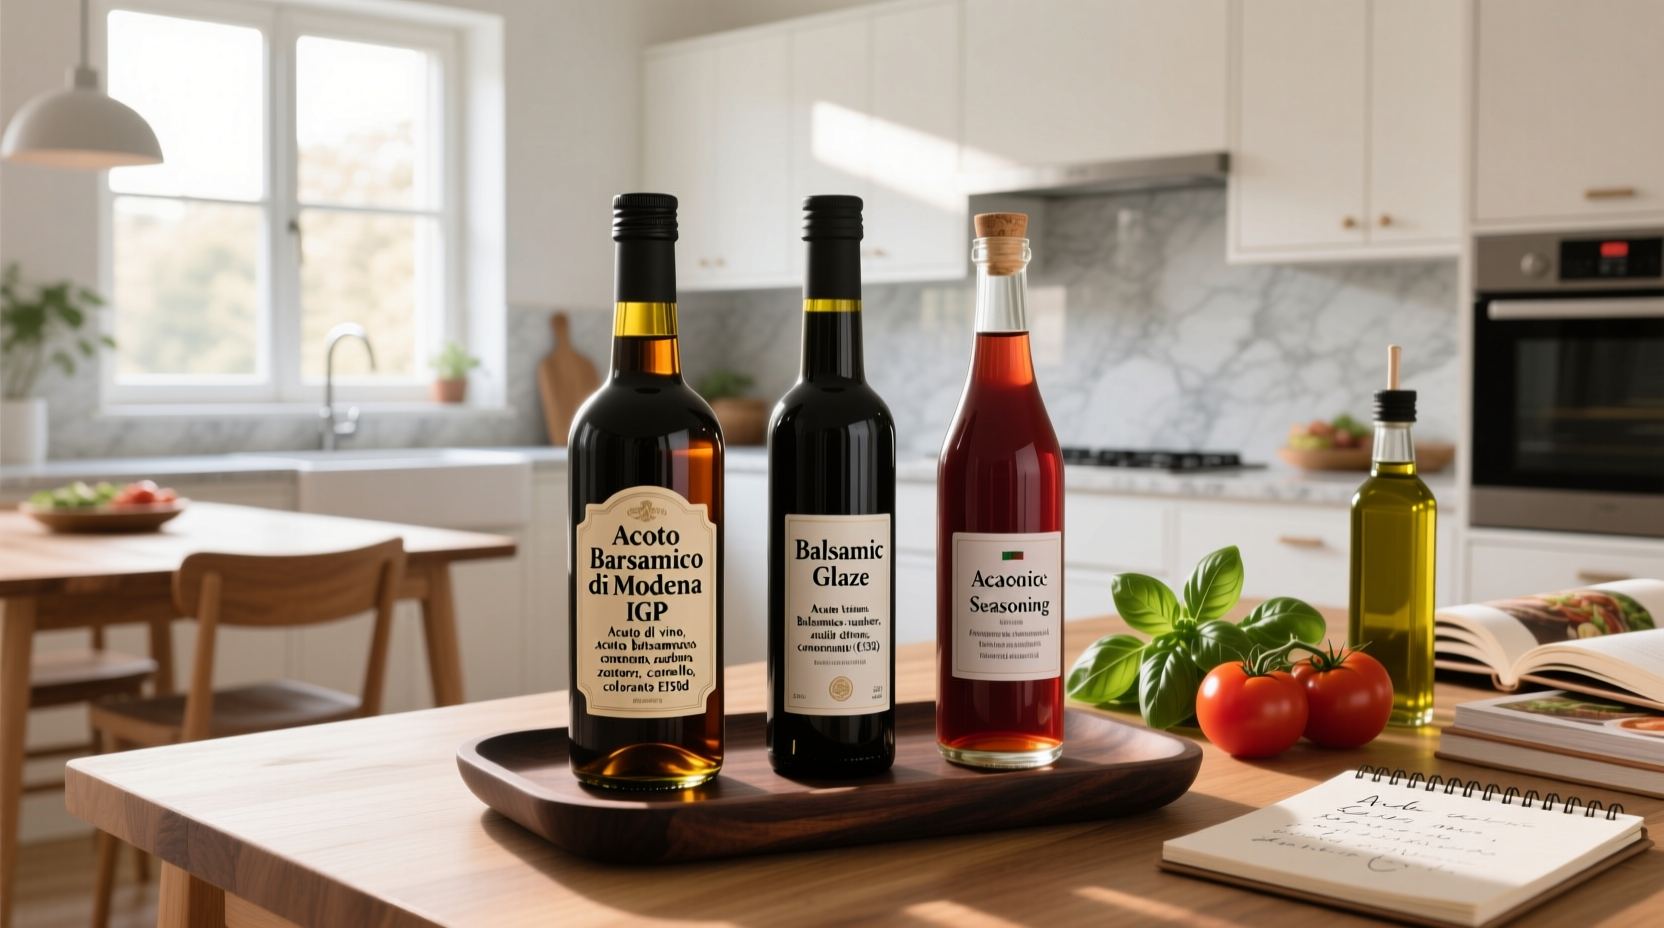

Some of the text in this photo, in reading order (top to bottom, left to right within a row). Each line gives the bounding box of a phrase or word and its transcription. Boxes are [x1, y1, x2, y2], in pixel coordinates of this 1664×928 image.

[612, 525, 680, 546] Acoto
[590, 547, 703, 570] Barsamico
[795, 539, 884, 560] Balsamic
[588, 573, 702, 595] di Modena
[813, 566, 869, 586] Glaze
[626, 601, 668, 622] IGP
[970, 596, 1050, 616] Seasoning
